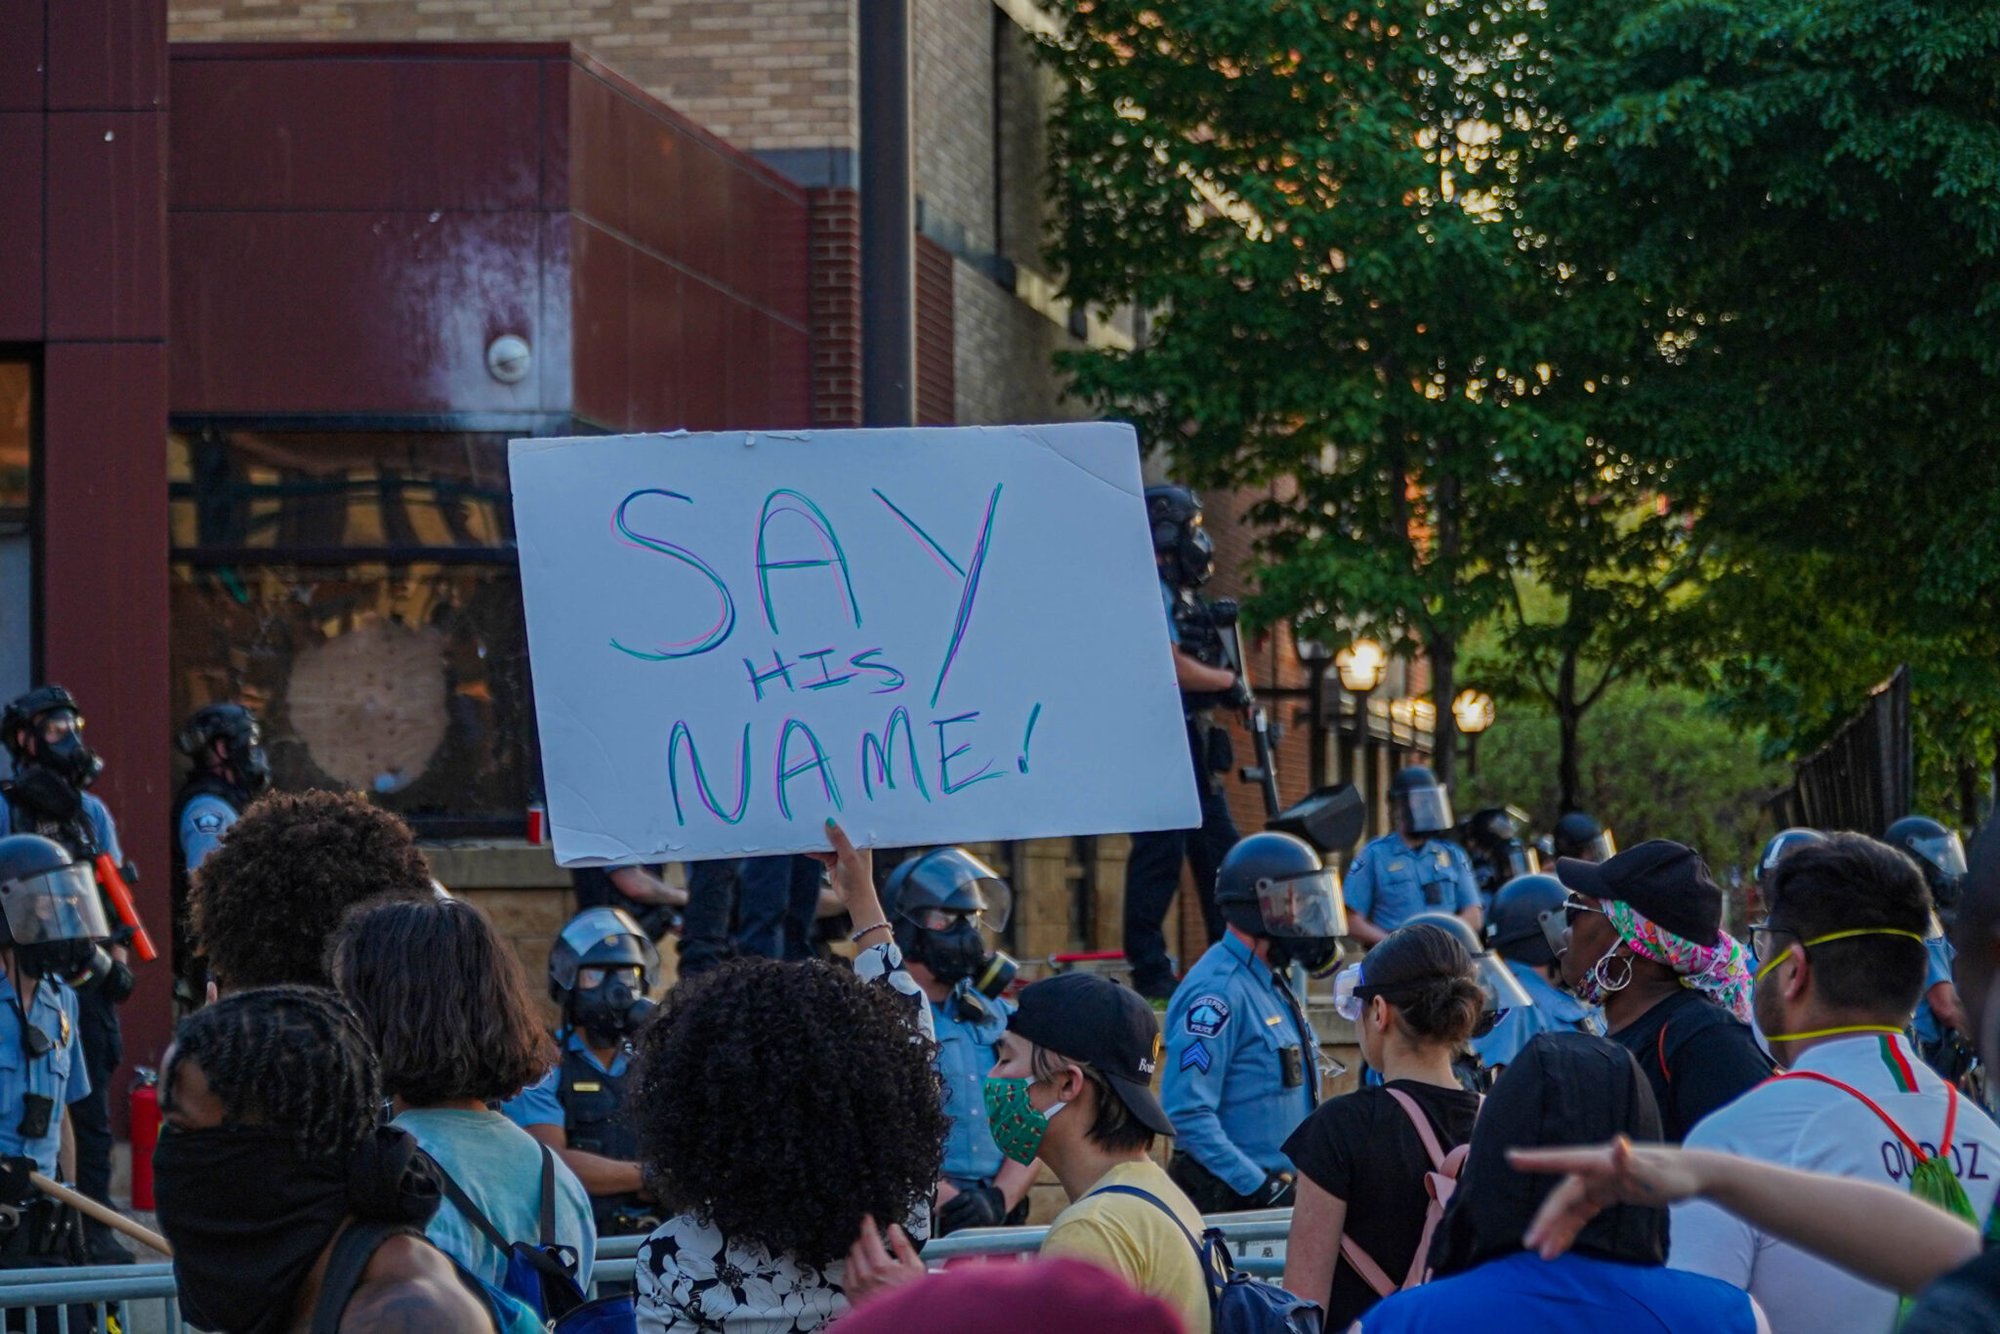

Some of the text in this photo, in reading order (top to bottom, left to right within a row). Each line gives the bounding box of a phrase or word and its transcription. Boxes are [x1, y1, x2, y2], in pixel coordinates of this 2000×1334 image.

[608, 483, 1003, 708] SAY
[742, 647, 906, 702] HIS
[668, 702, 1041, 826] NAME!
